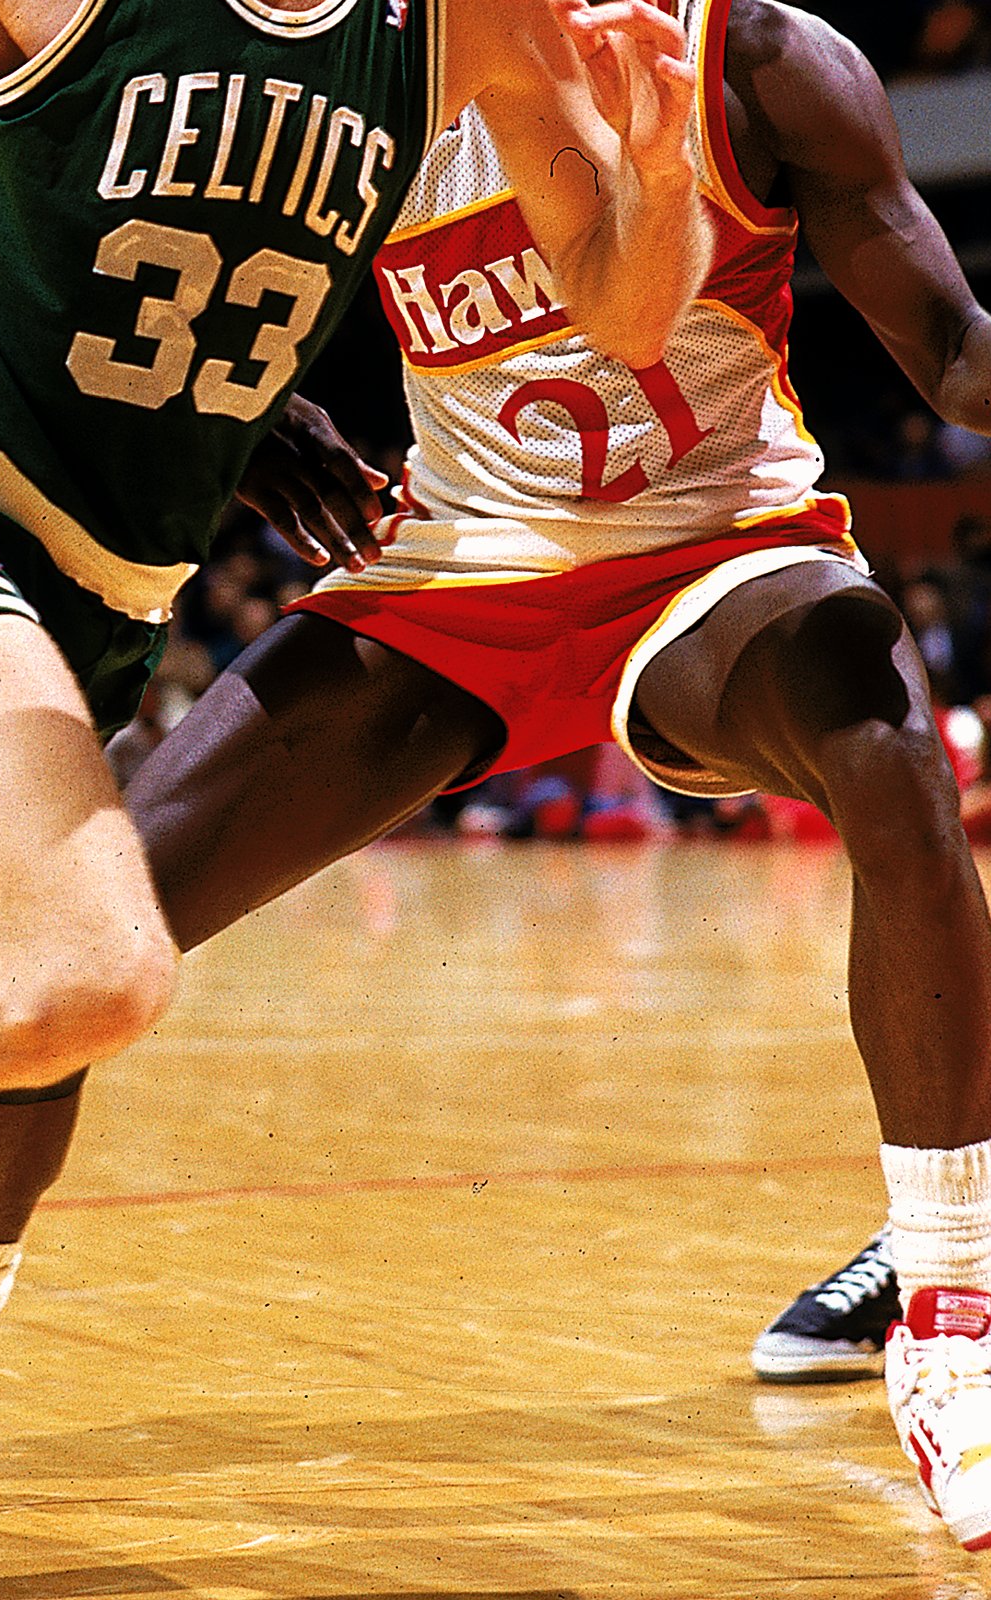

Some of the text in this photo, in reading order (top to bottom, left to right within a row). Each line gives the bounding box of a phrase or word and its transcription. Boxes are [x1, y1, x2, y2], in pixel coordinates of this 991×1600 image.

[97, 71, 396, 257] CELTICS
[64, 218, 333, 423] 33
[381, 247, 568, 354] Haw
[497, 358, 716, 503] 21
